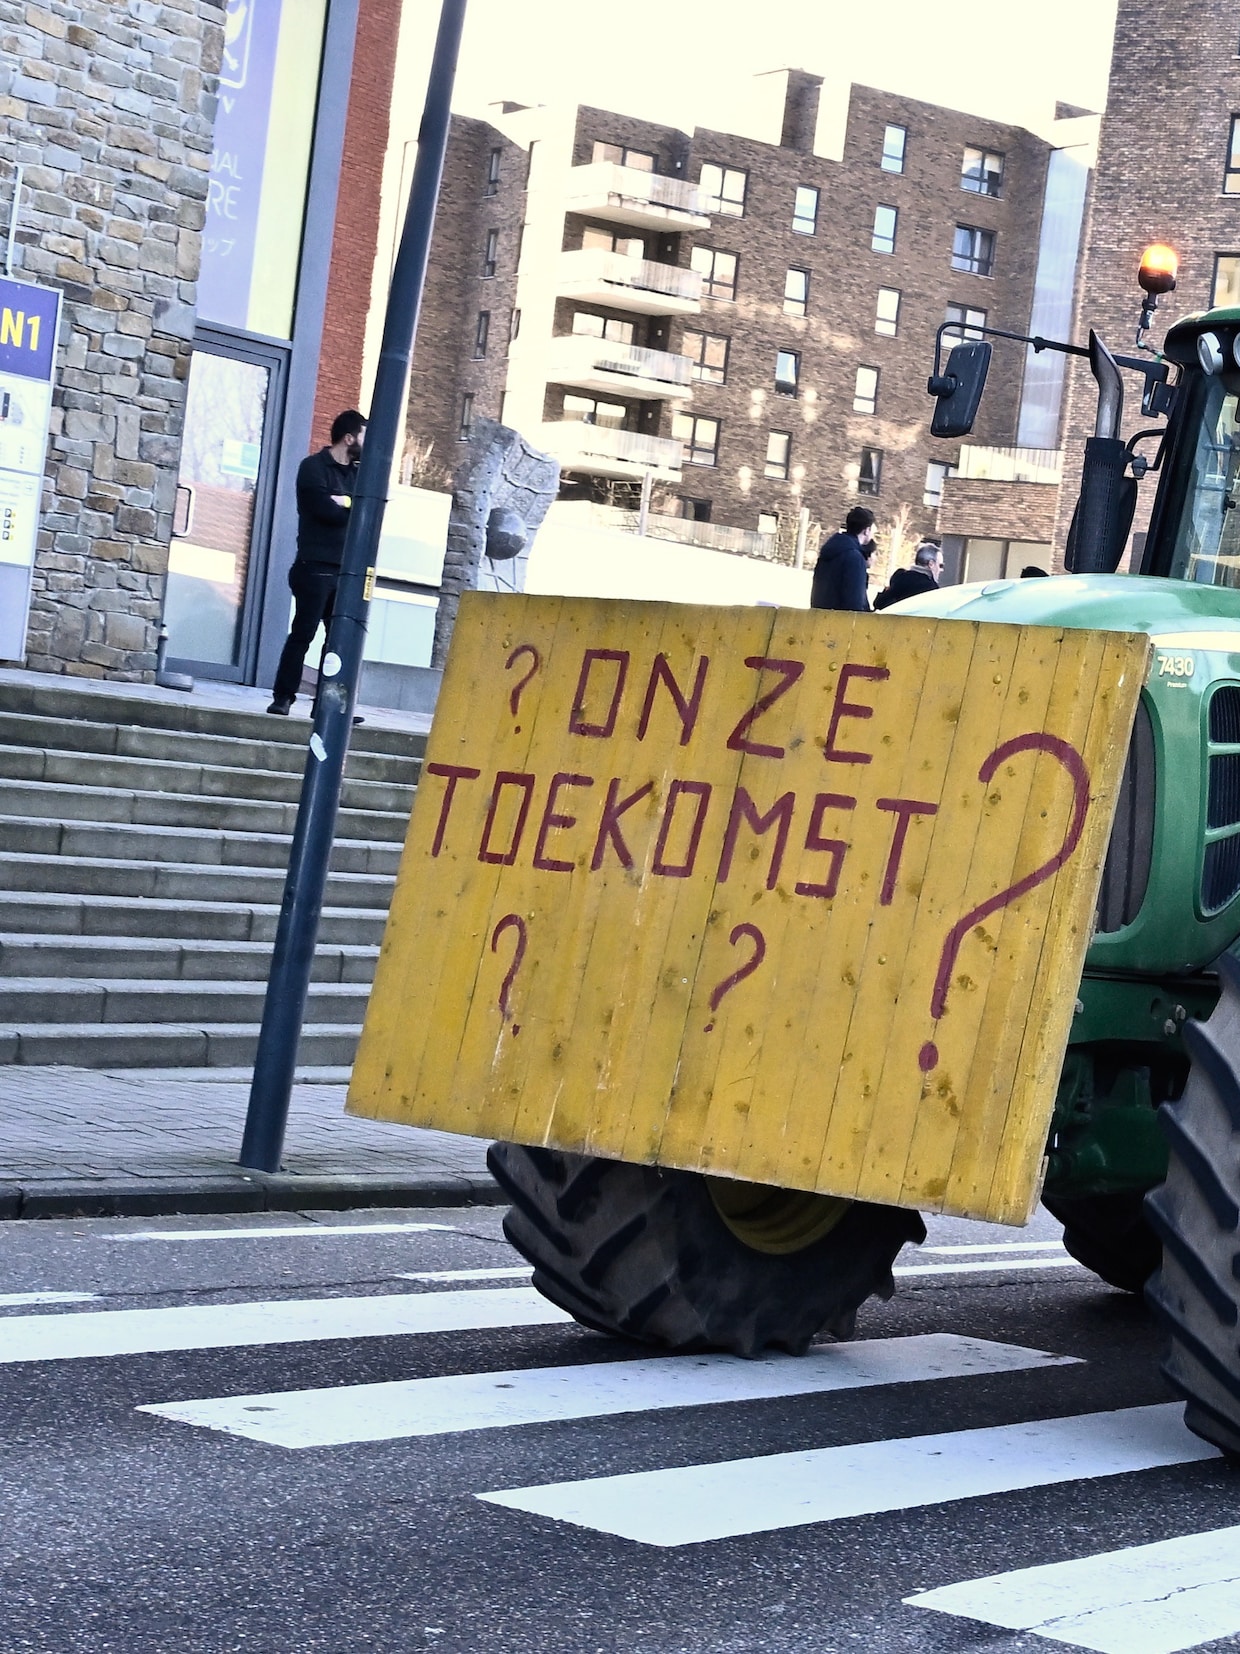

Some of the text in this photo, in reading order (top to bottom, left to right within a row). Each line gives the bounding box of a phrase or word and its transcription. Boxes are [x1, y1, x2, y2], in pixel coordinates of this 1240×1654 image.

[568, 649, 890, 764] ONZE
[1157, 655, 1195, 677] 7430
[427, 763, 938, 906] TOEKOMST
